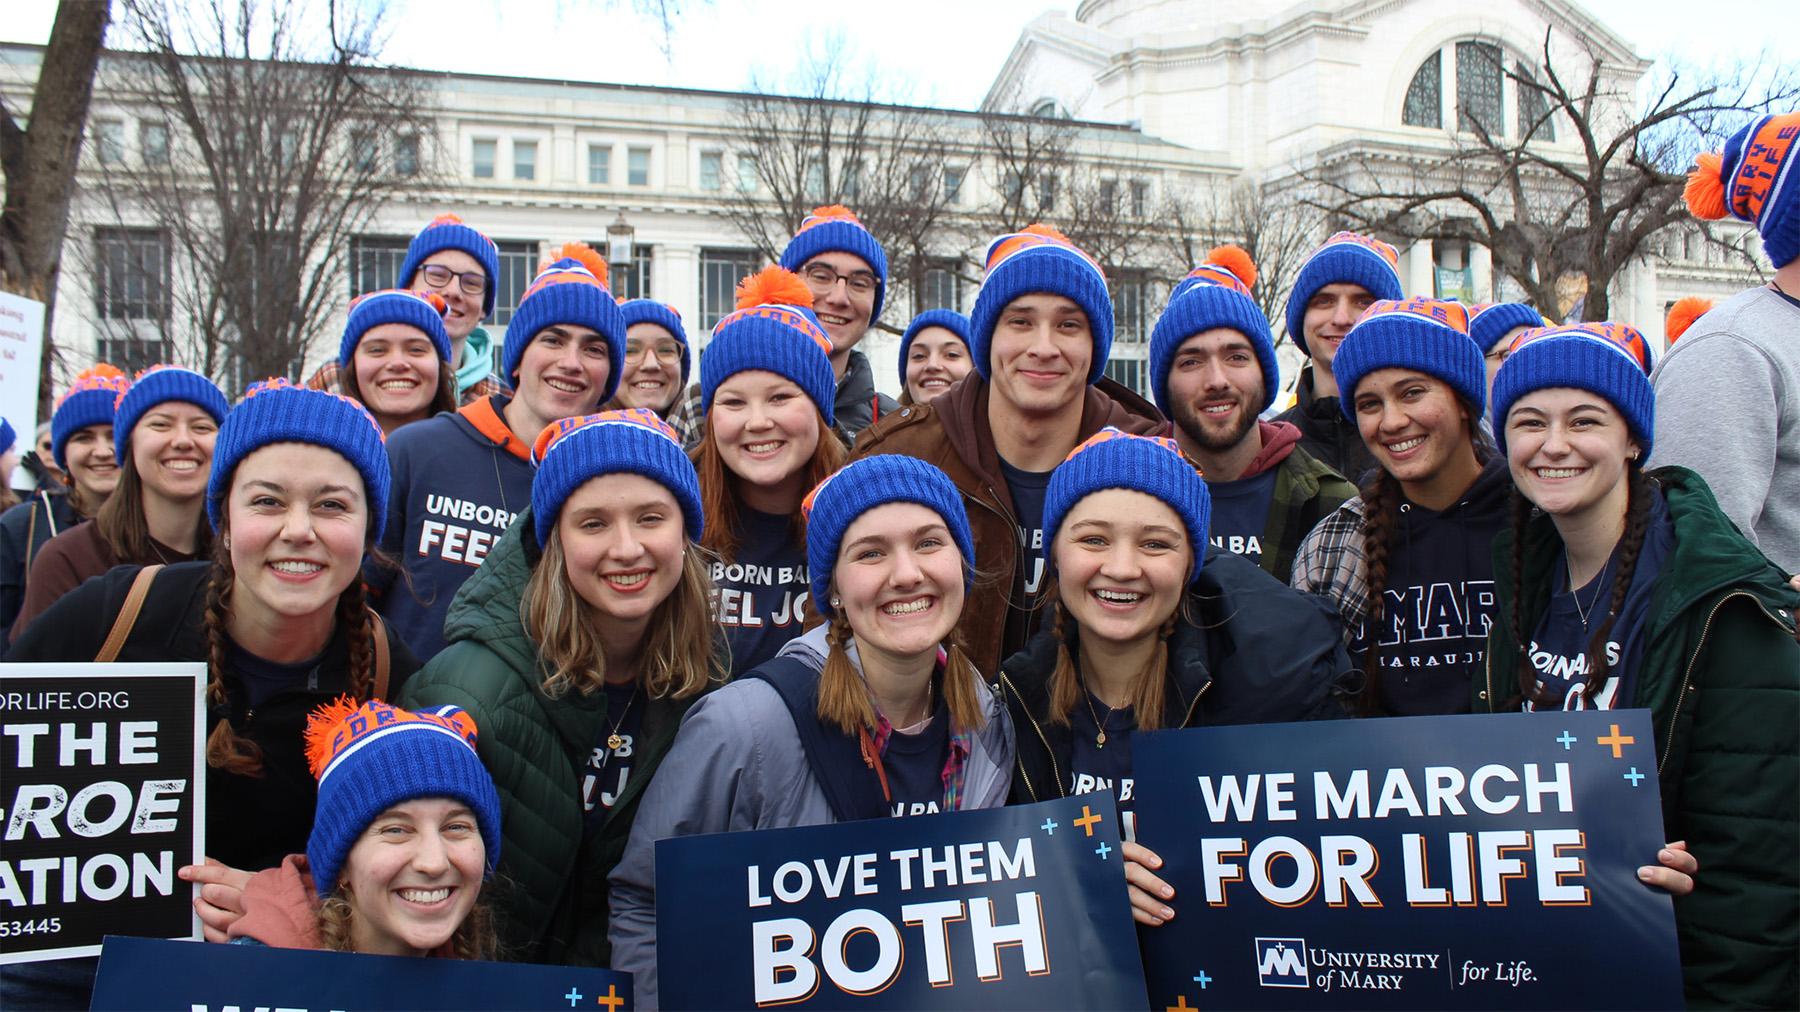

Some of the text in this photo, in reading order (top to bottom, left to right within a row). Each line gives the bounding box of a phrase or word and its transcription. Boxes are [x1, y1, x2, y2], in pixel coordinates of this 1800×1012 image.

[1752, 126, 1798, 202] LIFE
[706, 562, 772, 585] BORN
[4, 721, 158, 767] THE
[0, 779, 187, 841] ROE
[1198, 773, 1297, 822] WE
[1313, 763, 1573, 820] MARCH
[748, 838, 1036, 907] LOVE THEM
[1201, 829, 1591, 907] FOR LIFE
[752, 891, 1050, 1008] BOTH
[1459, 960, 1538, 987] for Life.
[1316, 970, 1336, 992] of
